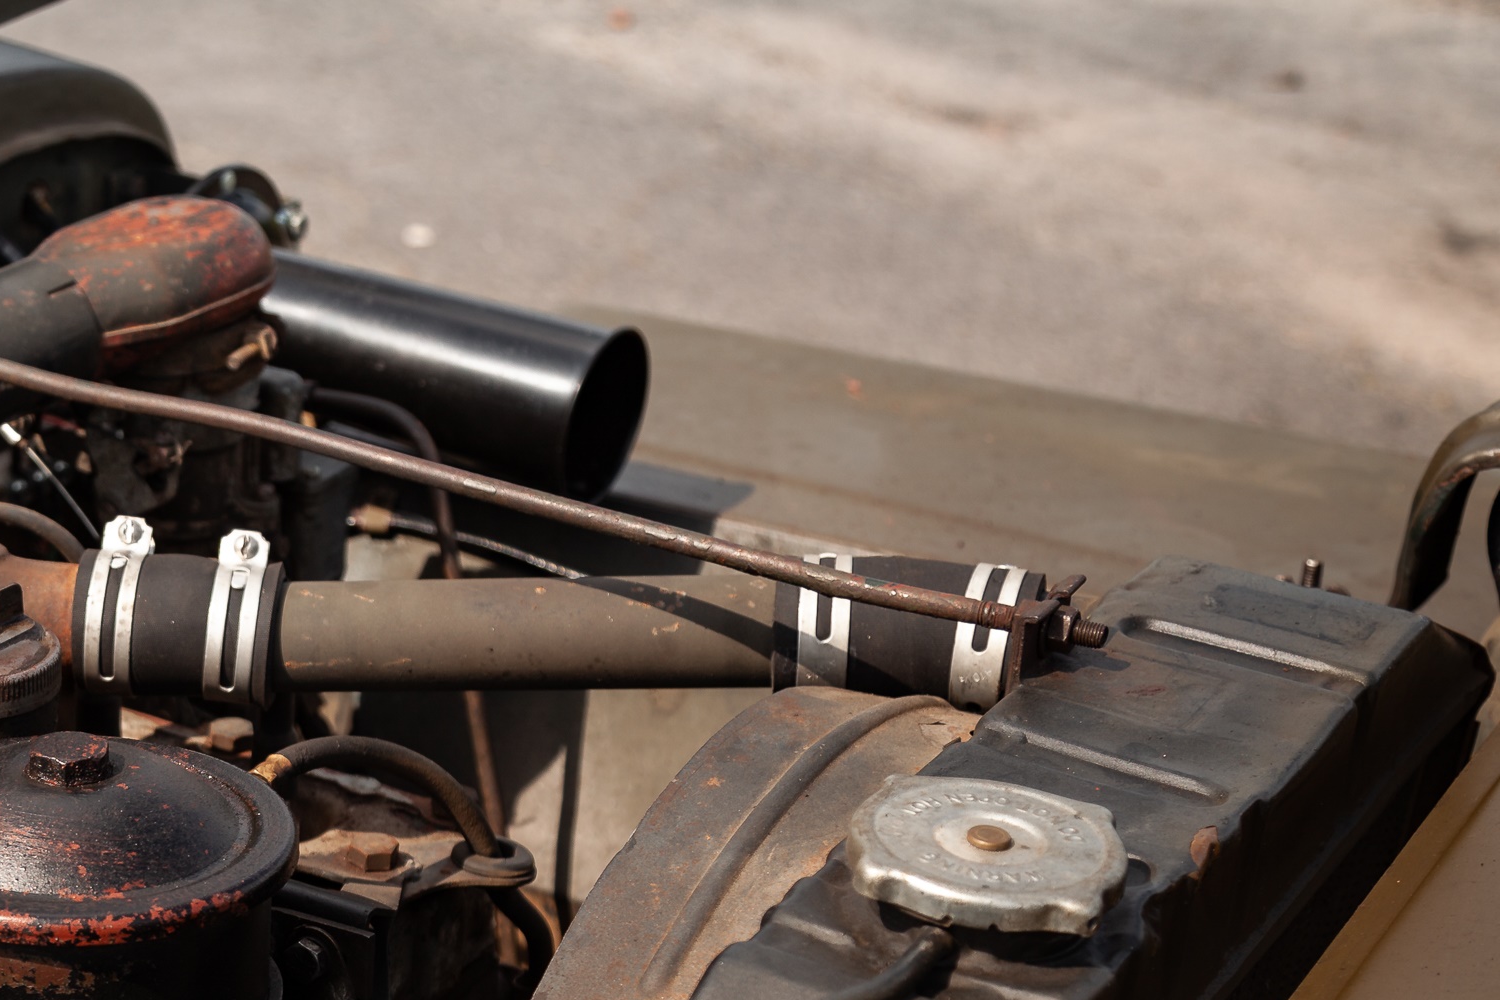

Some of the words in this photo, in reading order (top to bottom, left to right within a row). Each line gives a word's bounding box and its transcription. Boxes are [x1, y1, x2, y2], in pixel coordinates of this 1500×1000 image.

[902, 796, 943, 815] HOT
[946, 793, 1007, 807] OPEN
[919, 852, 1045, 883] WARNING
